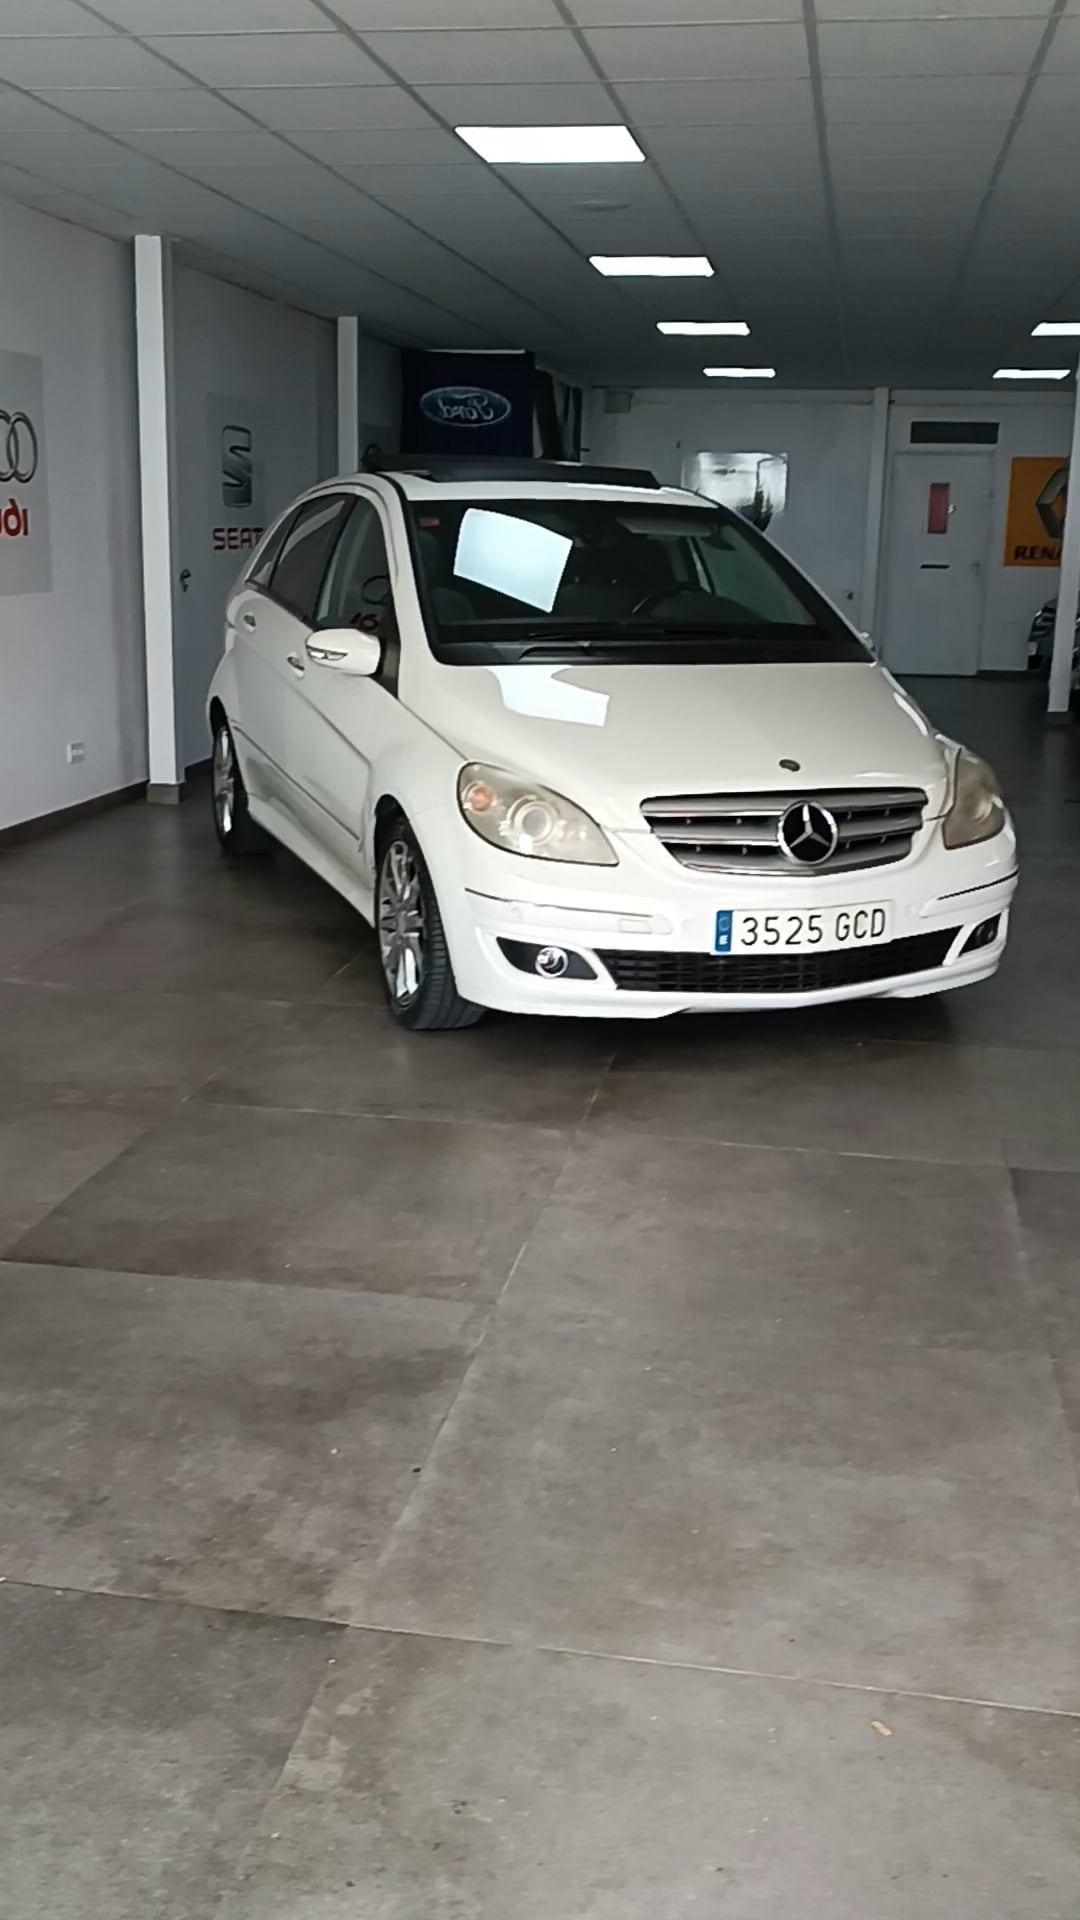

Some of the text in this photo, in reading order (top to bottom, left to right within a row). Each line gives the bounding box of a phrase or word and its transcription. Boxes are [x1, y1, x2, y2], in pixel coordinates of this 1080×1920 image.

[0, 498, 29, 537] di
[213, 527, 264, 550] SEAT
[740, 908, 887, 946] 3525 GCD
